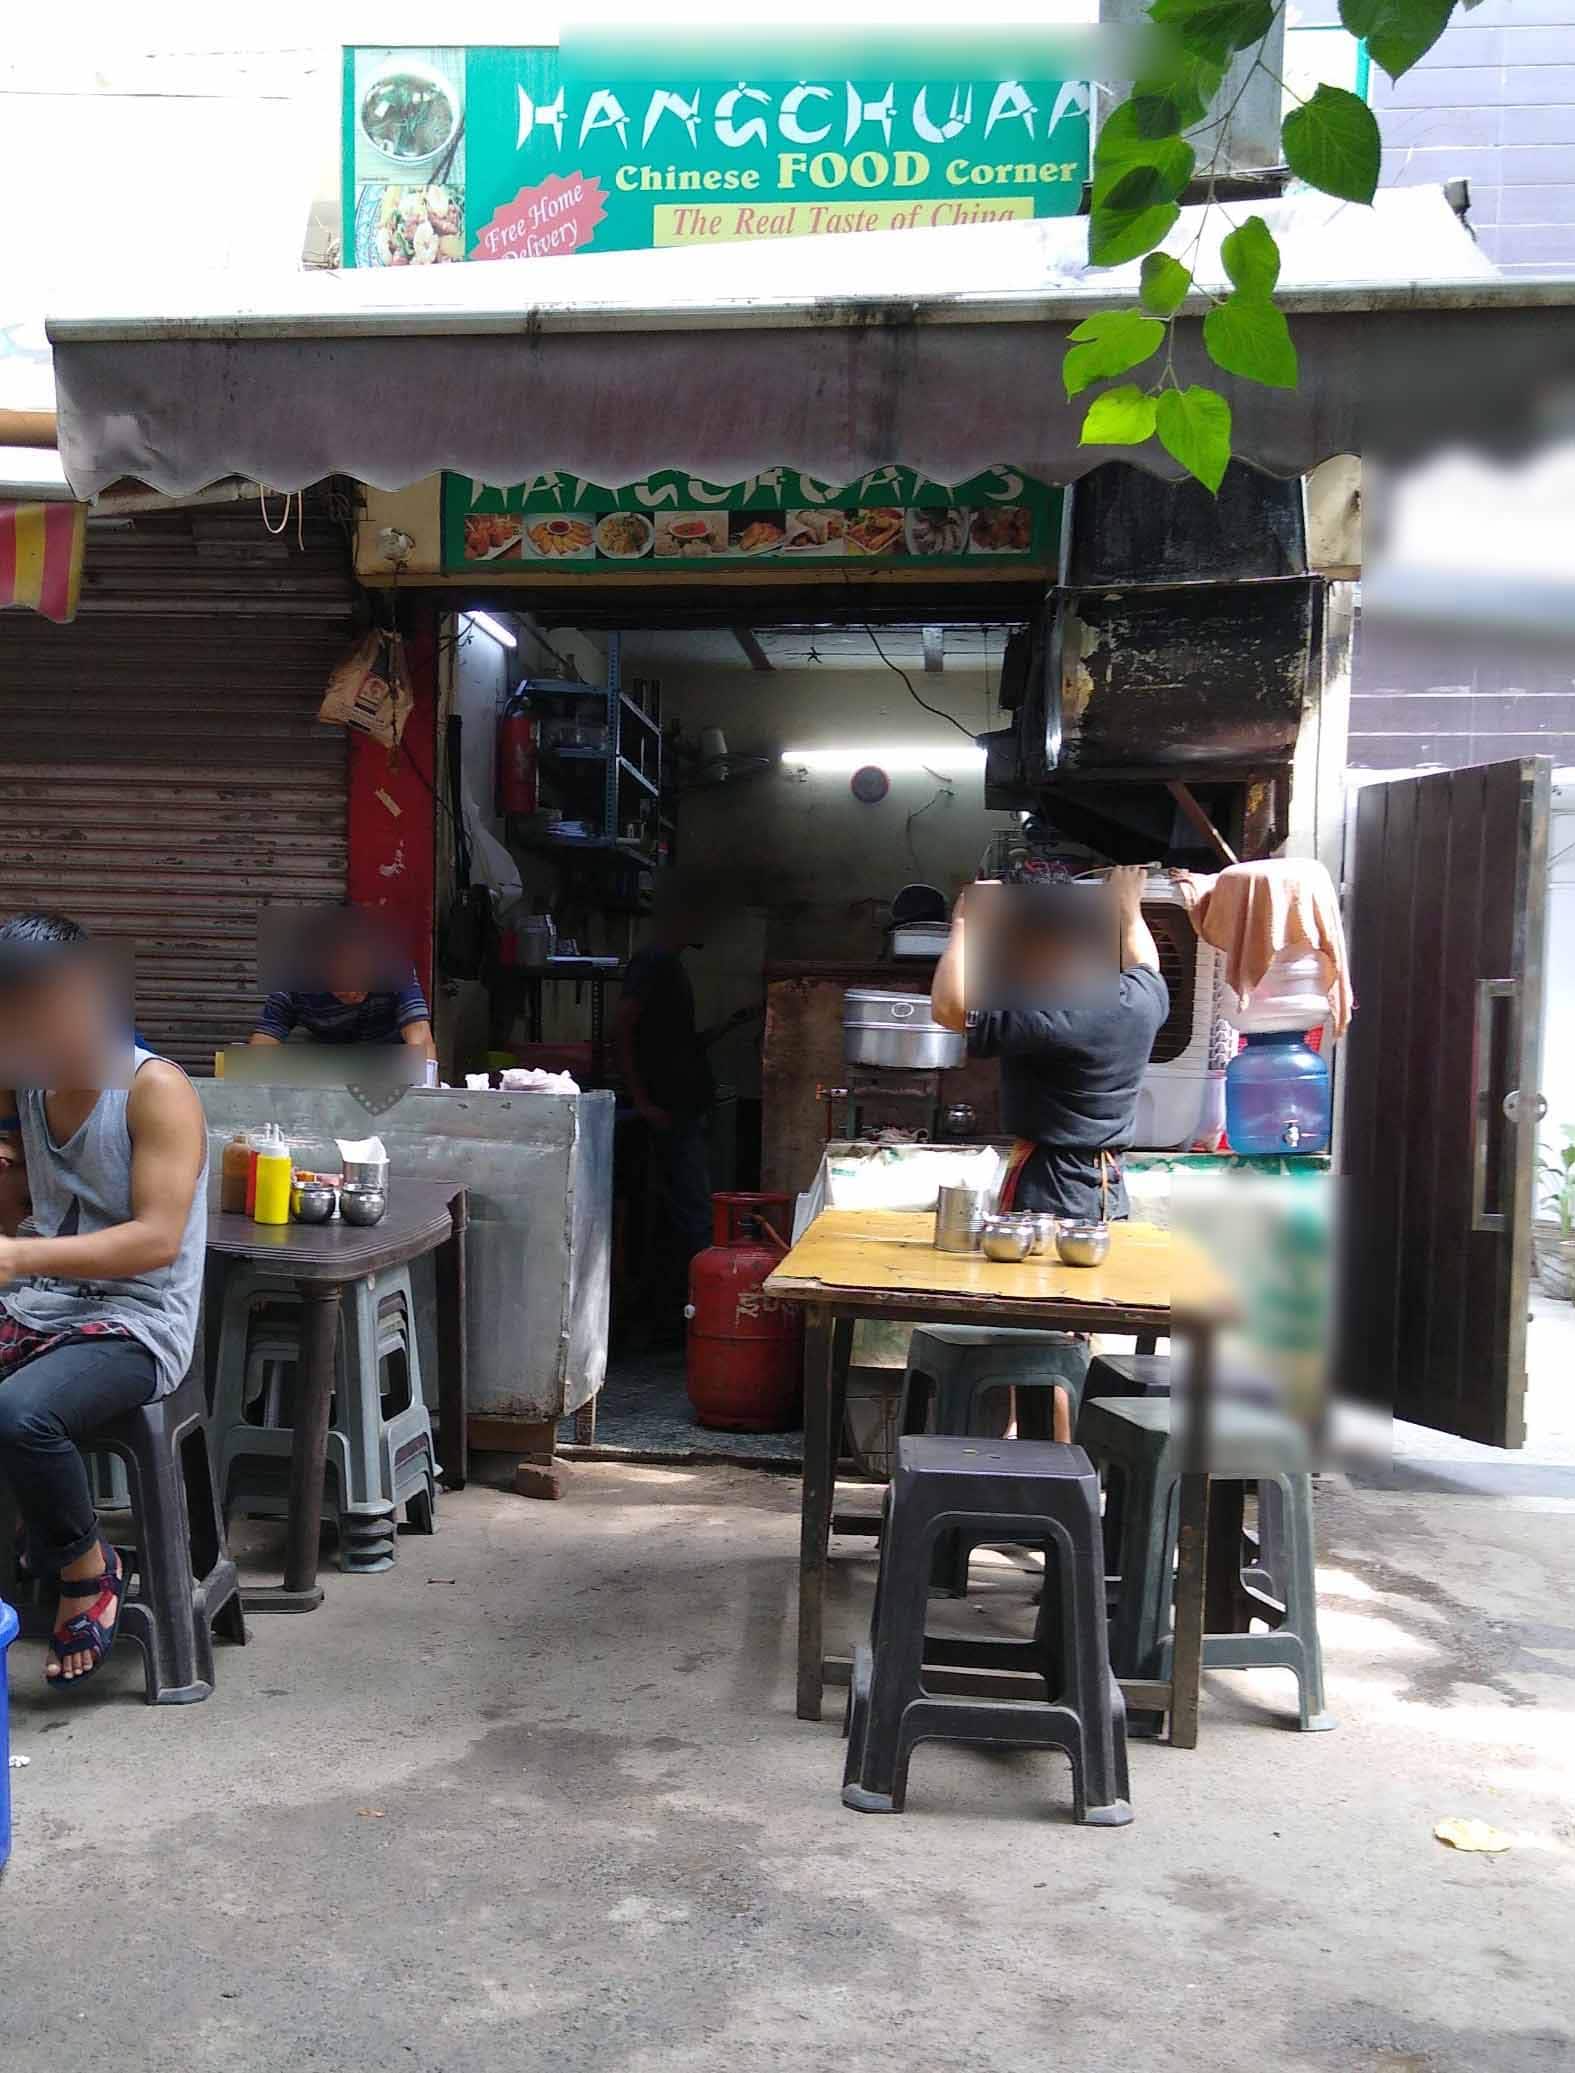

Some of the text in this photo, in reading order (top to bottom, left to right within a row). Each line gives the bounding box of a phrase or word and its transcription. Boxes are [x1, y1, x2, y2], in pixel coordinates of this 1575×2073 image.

[615, 152, 1078, 192] Chinese FOOD Corner
[484, 184, 585, 254] Free Home
[673, 202, 1016, 236] The Real Taste of China
